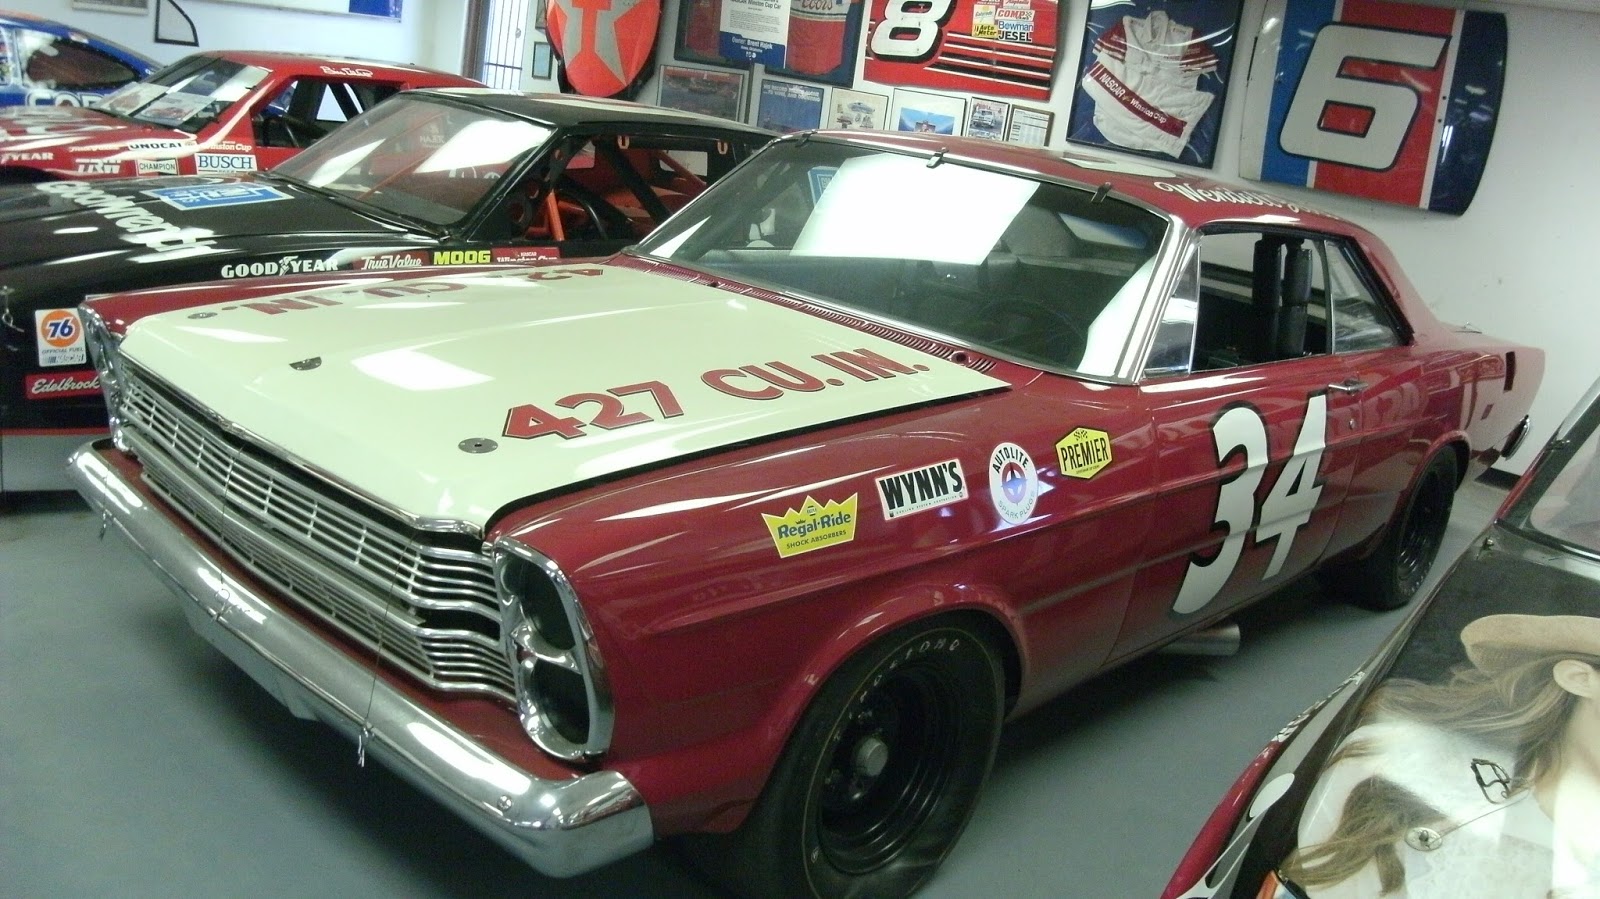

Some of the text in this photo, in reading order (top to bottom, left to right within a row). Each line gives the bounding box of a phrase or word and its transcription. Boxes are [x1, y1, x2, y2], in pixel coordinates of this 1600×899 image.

[998, 9, 1025, 18] COMP
[998, 20, 1034, 31] Bowman
[998, 30, 1032, 42] JESEL
[1099, 72, 1167, 124] NASCAR Winston Cup
[1280, 22, 1452, 172] 6
[138, 161, 176, 173] CHAMPION
[199, 154, 253, 170] BUSCH
[434, 250, 491, 266] MOOG
[45, 317, 75, 340] 76
[31, 376, 100, 394] Edelbrock
[502, 380, 684, 440] 427
[992, 446, 1029, 474] AUTOLITE
[1060, 437, 1109, 471] PREMIER
[879, 461, 963, 511] WYNN'S
[998, 499, 1019, 519] SPARK
[1171, 393, 1328, 615] 34
[786, 529, 847, 549] SHOCK ABSORBERS
